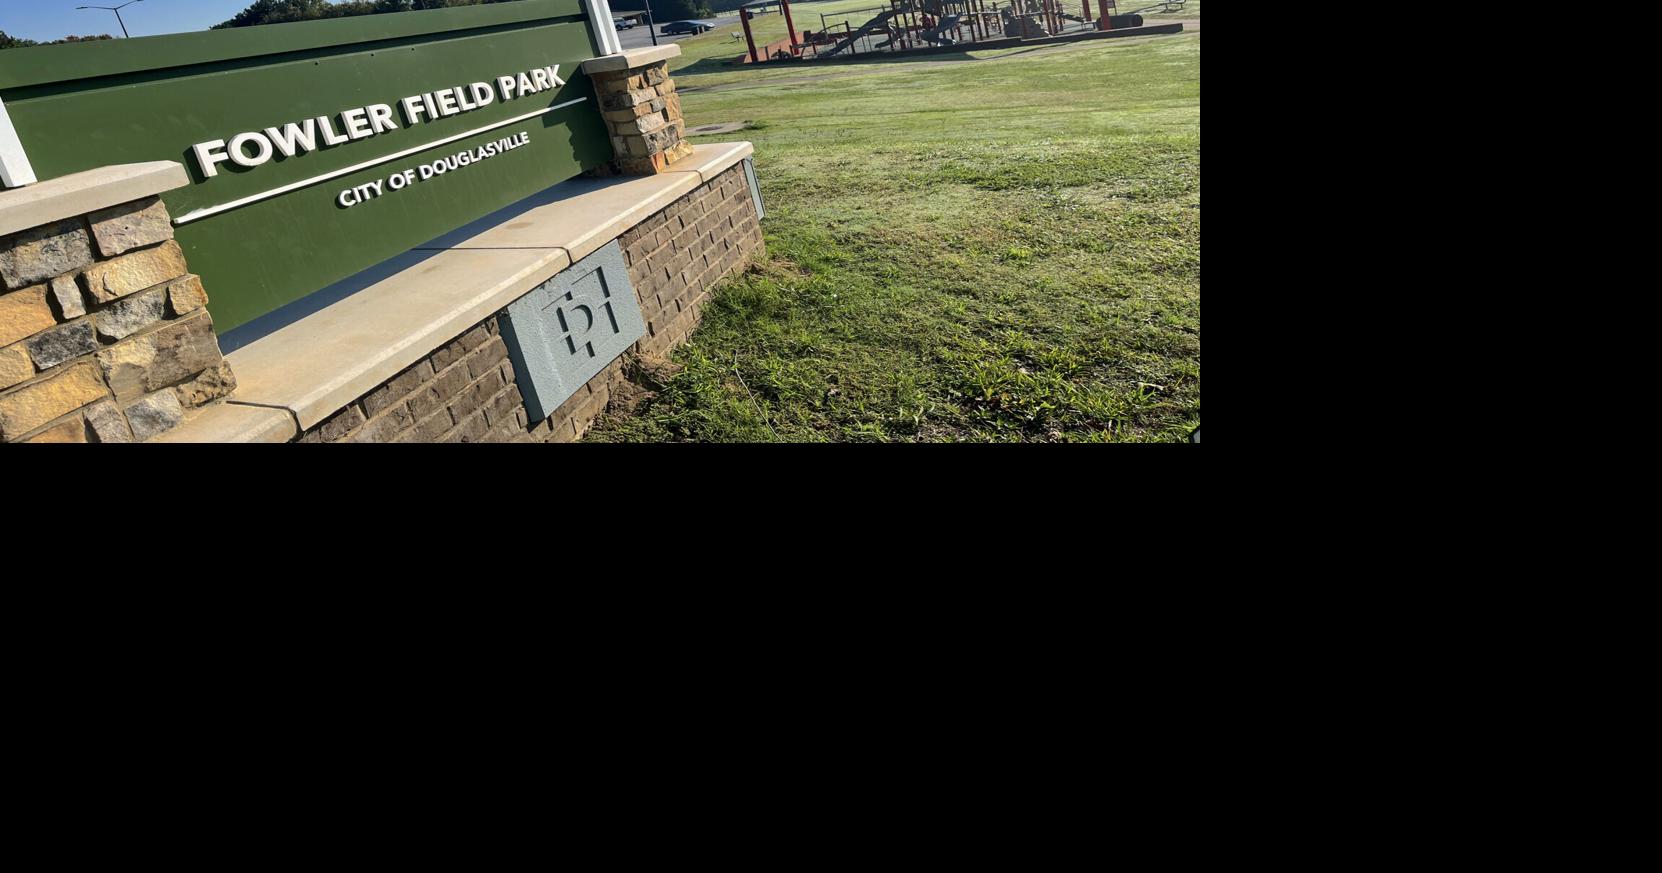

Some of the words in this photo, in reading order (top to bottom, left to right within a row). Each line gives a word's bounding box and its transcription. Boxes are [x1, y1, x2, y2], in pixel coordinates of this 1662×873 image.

[192, 102, 399, 178] FOWLER
[401, 81, 496, 125] FIELD
[496, 64, 566, 100] PARK
[338, 178, 384, 208] CITY
[388, 168, 416, 190] OF
[418, 131, 531, 181] DOUGLASVILLE
